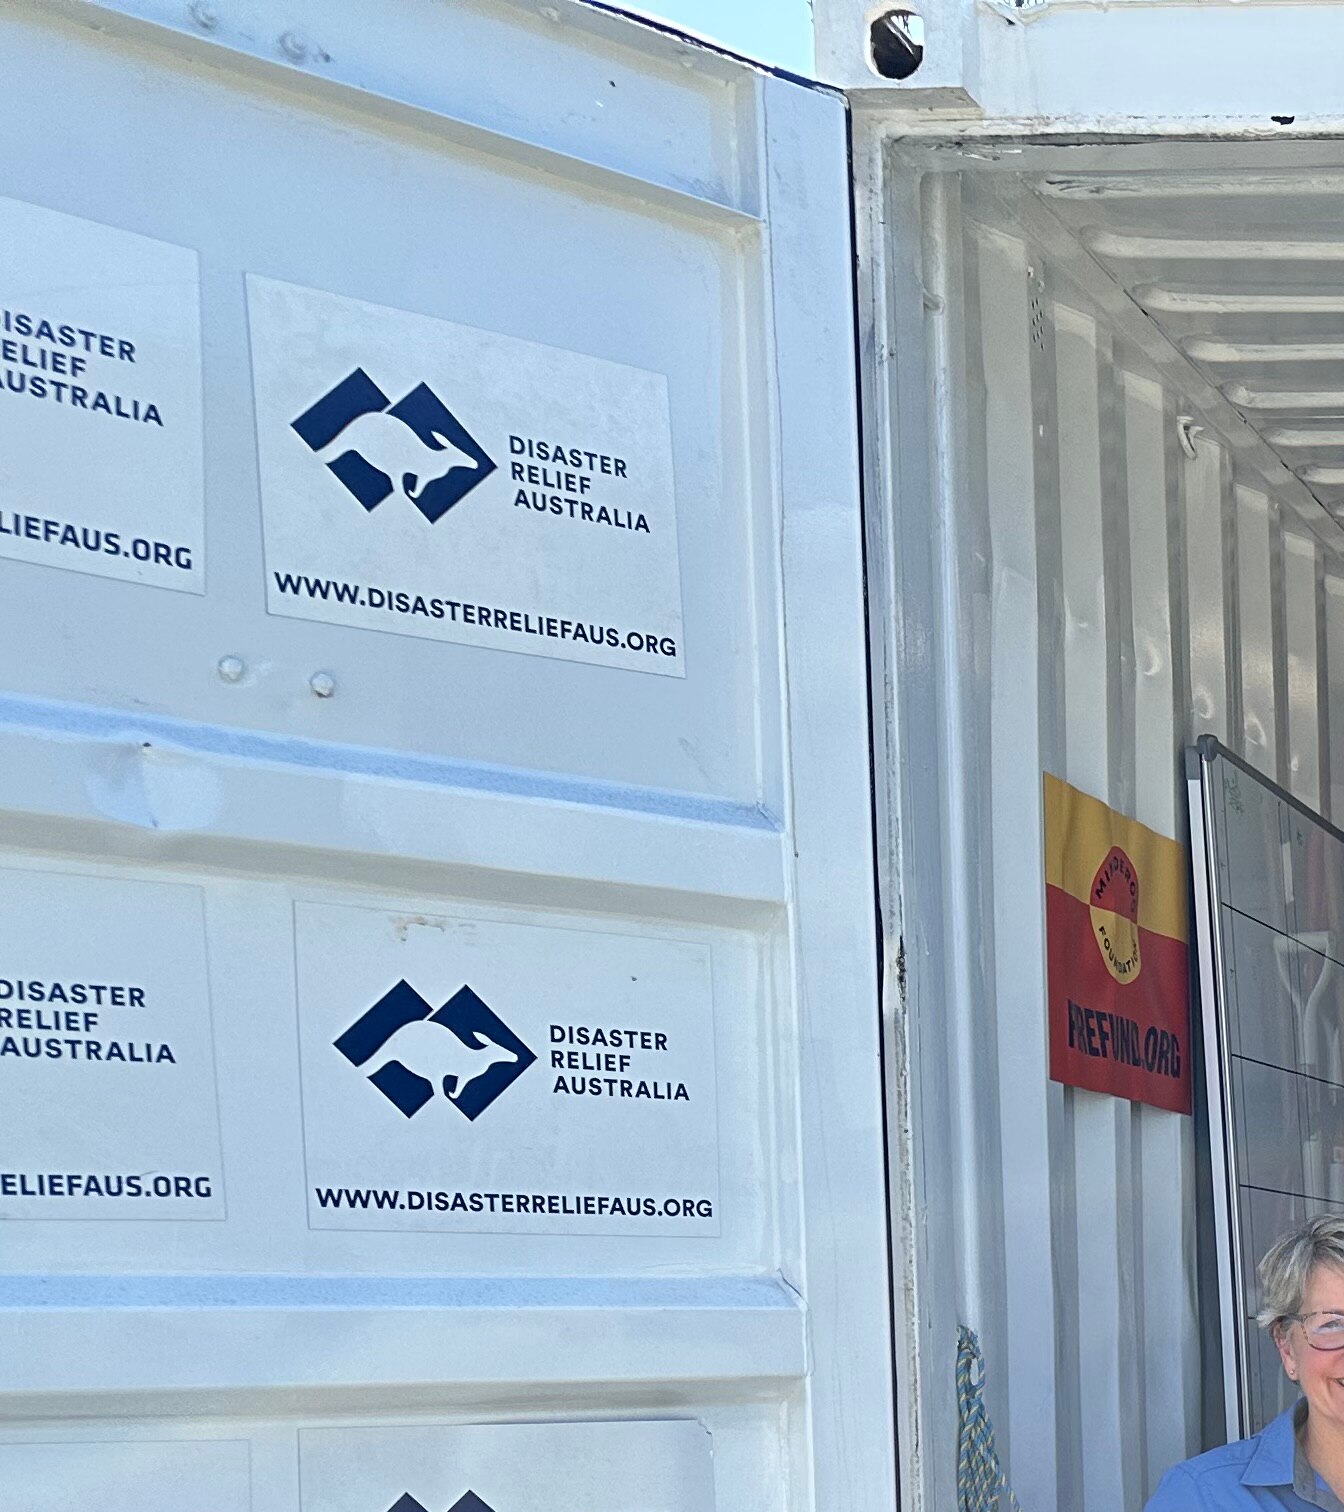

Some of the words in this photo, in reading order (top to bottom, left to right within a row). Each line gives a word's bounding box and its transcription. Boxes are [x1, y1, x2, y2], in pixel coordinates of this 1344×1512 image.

[2, 310, 137, 364] ISASTER
[1, 337, 88, 378] ELIEF
[0, 367, 164, 427] USTRALIA
[508, 435, 628, 479] DISASTER
[510, 461, 592, 495] RELIEF
[514, 488, 652, 534] AUSTRALIA
[274, 570, 678, 658] WWW.DISASTERRELIEFAUS.ORG
[0, 979, 147, 1008] DISASTER
[0, 1007, 99, 1032] RELIEF
[0, 1035, 177, 1064] AUSTRALIA
[549, 1024, 669, 1052] DISASTER
[550, 1050, 632, 1073] RELIEF
[553, 1076, 691, 1102] AUSTRALIA
[315, 1187, 714, 1219] WWW.DISASTERRELIEFAUS.ORG
